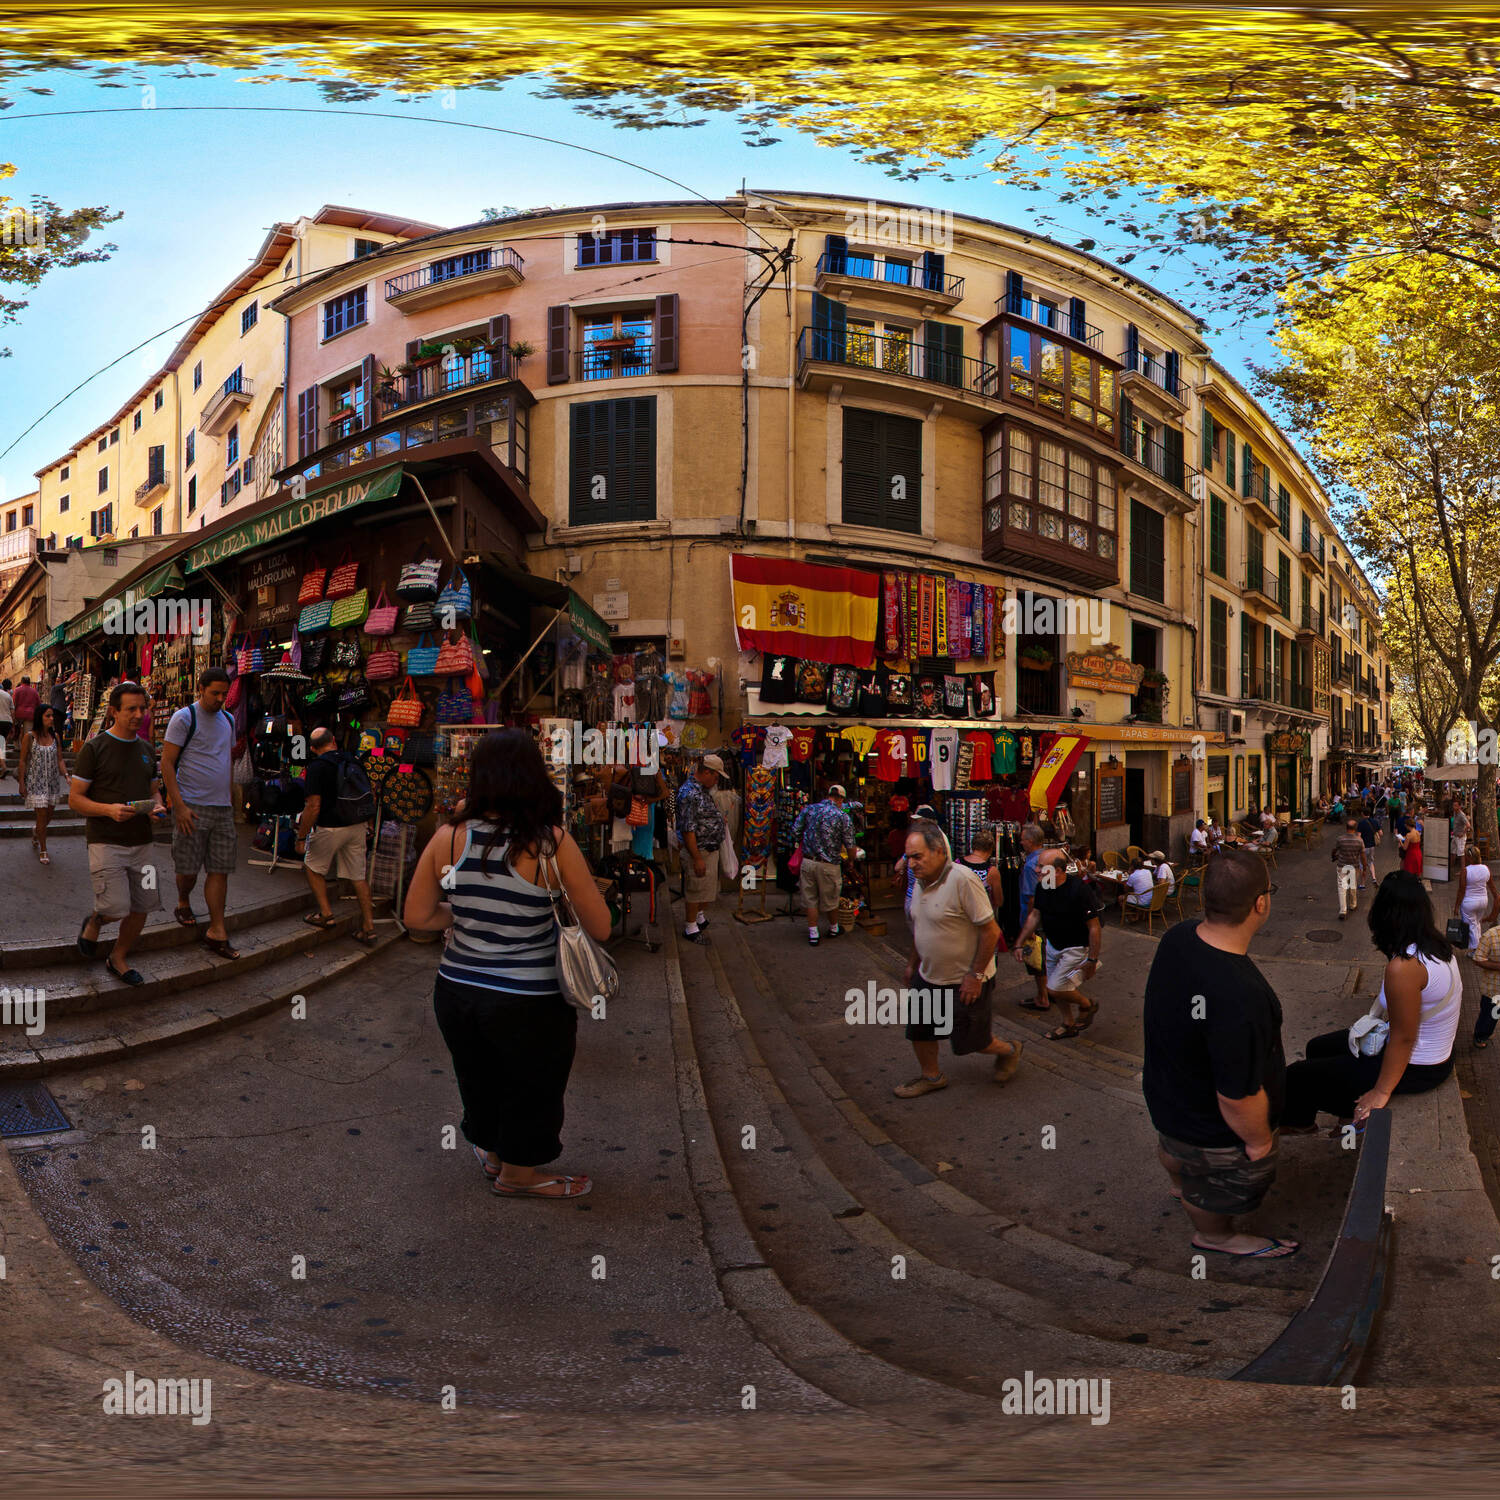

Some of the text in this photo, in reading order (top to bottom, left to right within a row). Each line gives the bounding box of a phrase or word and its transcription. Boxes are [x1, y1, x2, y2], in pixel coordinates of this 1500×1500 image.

[192, 549, 211, 570] LA
[213, 531, 251, 559] LOZA
[1120, 729, 1148, 740] TAPAS
[799, 741, 809, 755] 9
[912, 743, 927, 763] 10
[939, 745, 949, 763] 9
